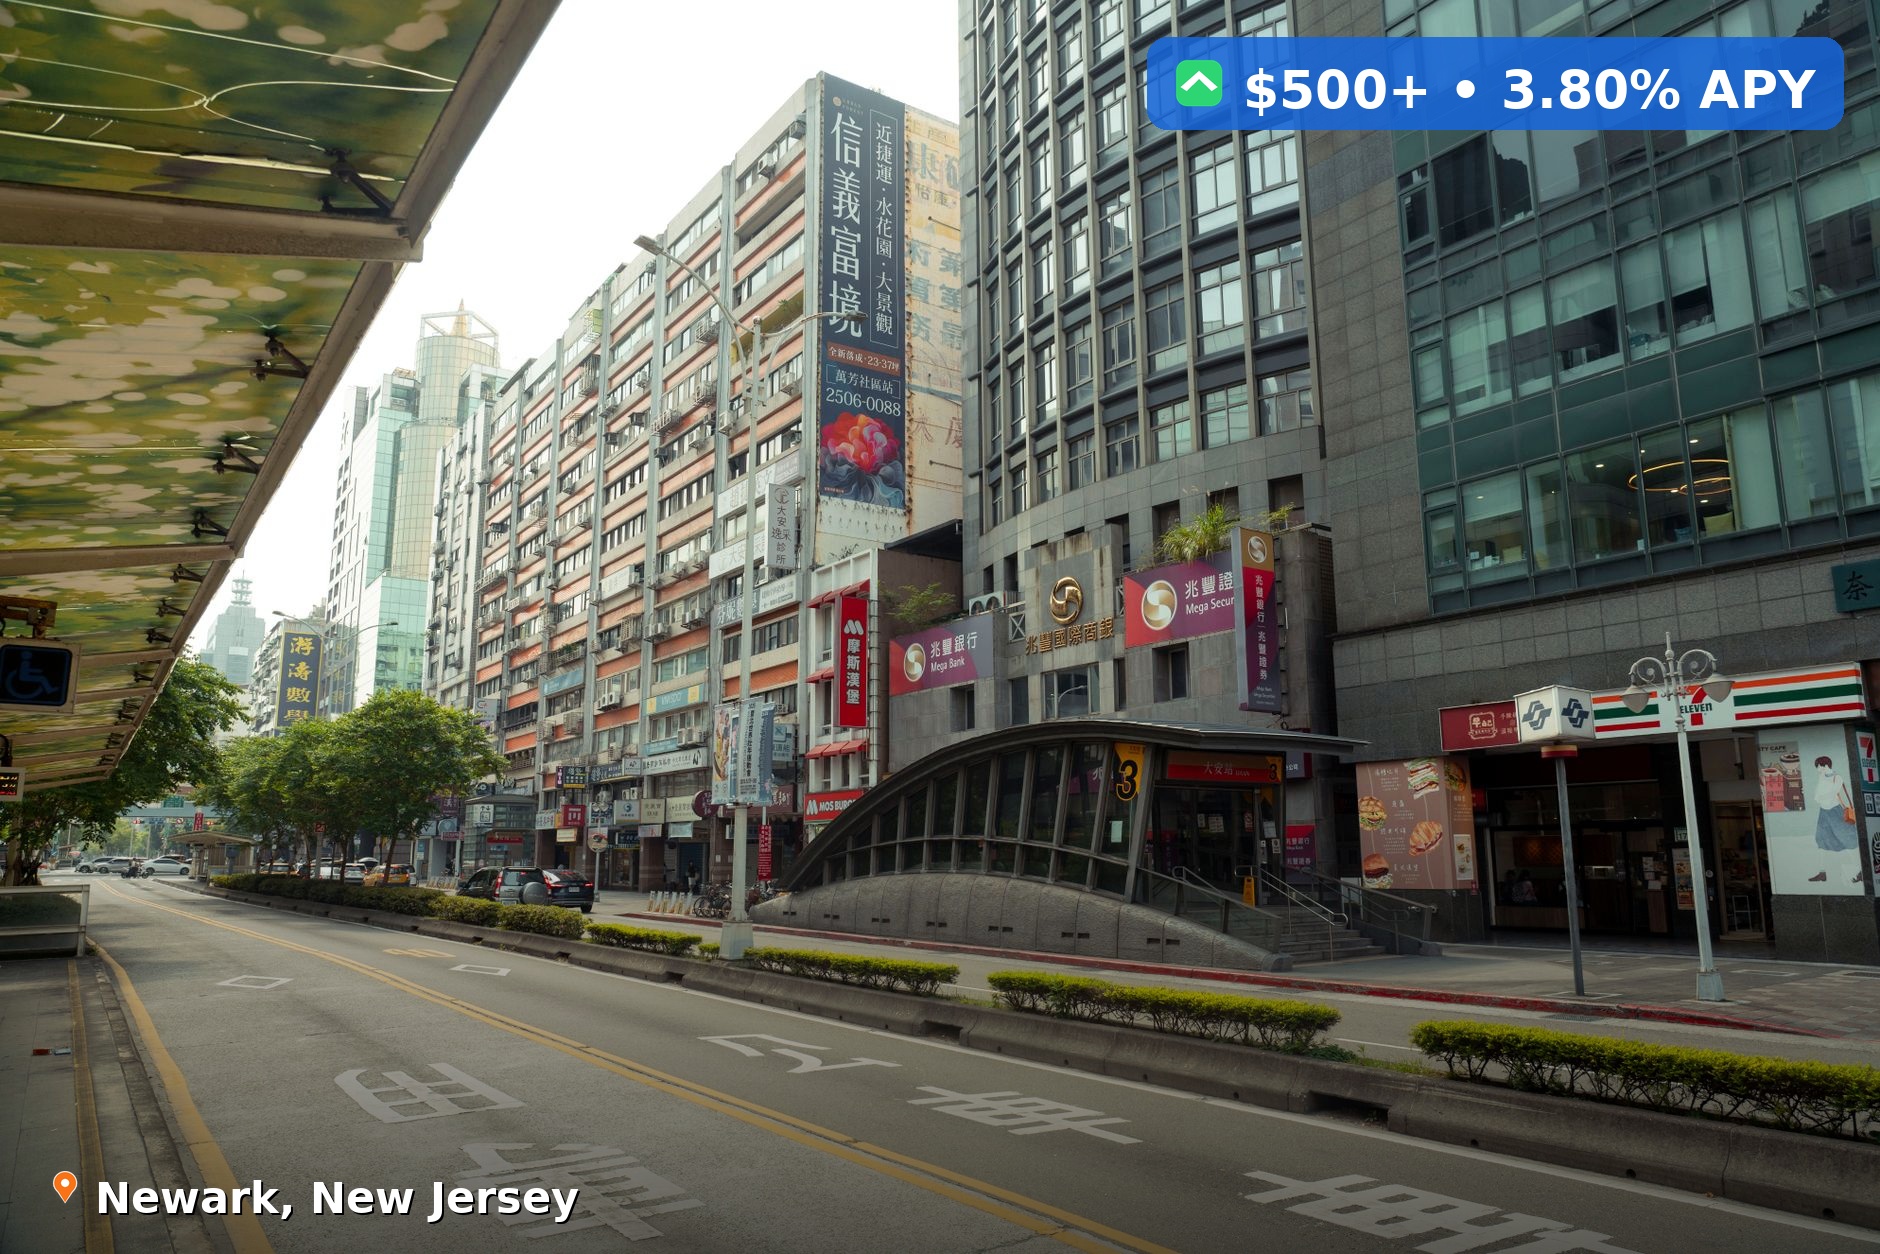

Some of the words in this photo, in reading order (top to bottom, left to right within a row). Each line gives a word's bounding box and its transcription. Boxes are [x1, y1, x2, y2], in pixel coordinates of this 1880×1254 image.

[829, 112, 863, 338] 信義富境
[835, 369, 894, 395] 萬芳社區站
[826, 387, 901, 417] 2506-0088
[1185, 602, 1209, 615] Mega
[930, 631, 979, 658] 兆豐銀行
[1025, 616, 1115, 656] 兆豐國際商銀
[846, 638, 861, 706] 摩斯漢堡
[930, 661, 948, 674] Mega
[949, 656, 966, 669] Bank
[1116, 759, 1138, 801] 3
[818, 801, 834, 812] MOS
